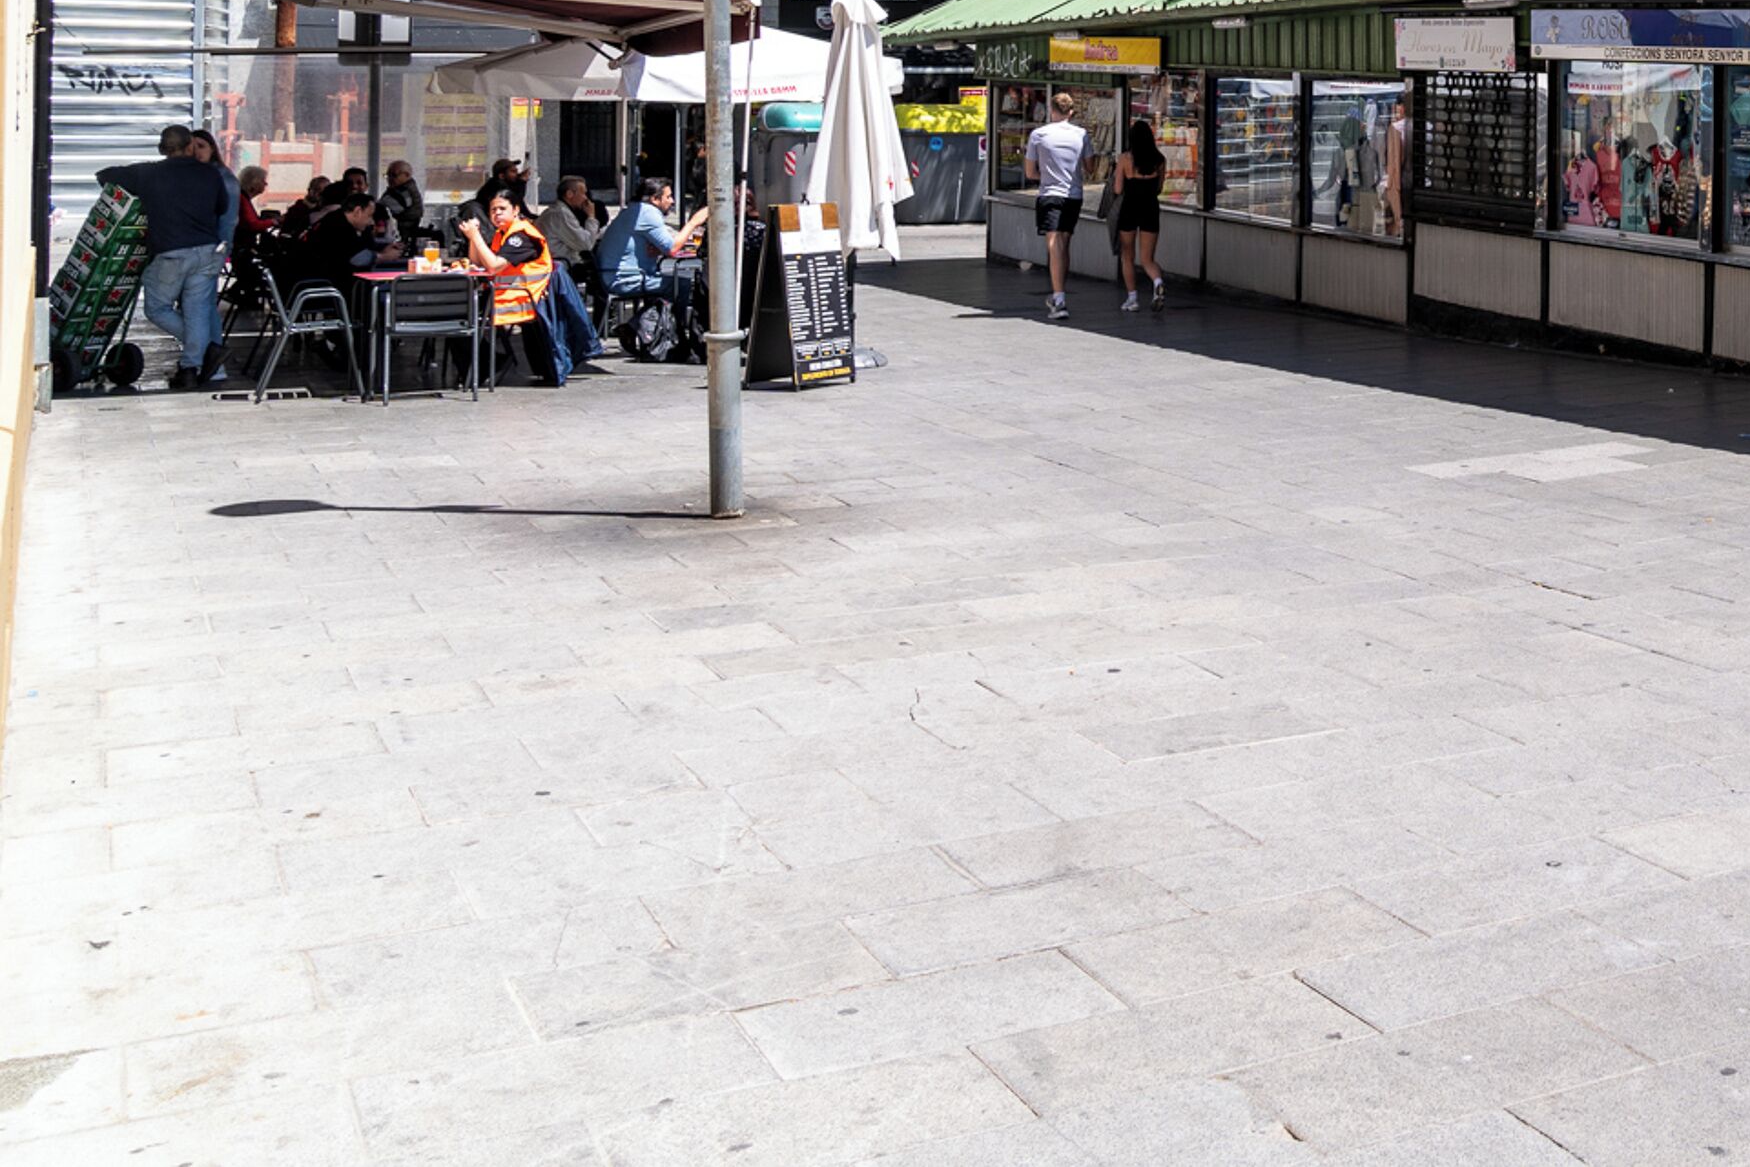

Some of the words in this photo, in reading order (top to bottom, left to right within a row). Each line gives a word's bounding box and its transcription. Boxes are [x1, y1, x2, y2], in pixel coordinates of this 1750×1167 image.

[1603, 47, 1662, 60] CONFECCIONS
[1664, 49, 1704, 61] SENYORA
[1707, 50, 1744, 62] SENYOR
